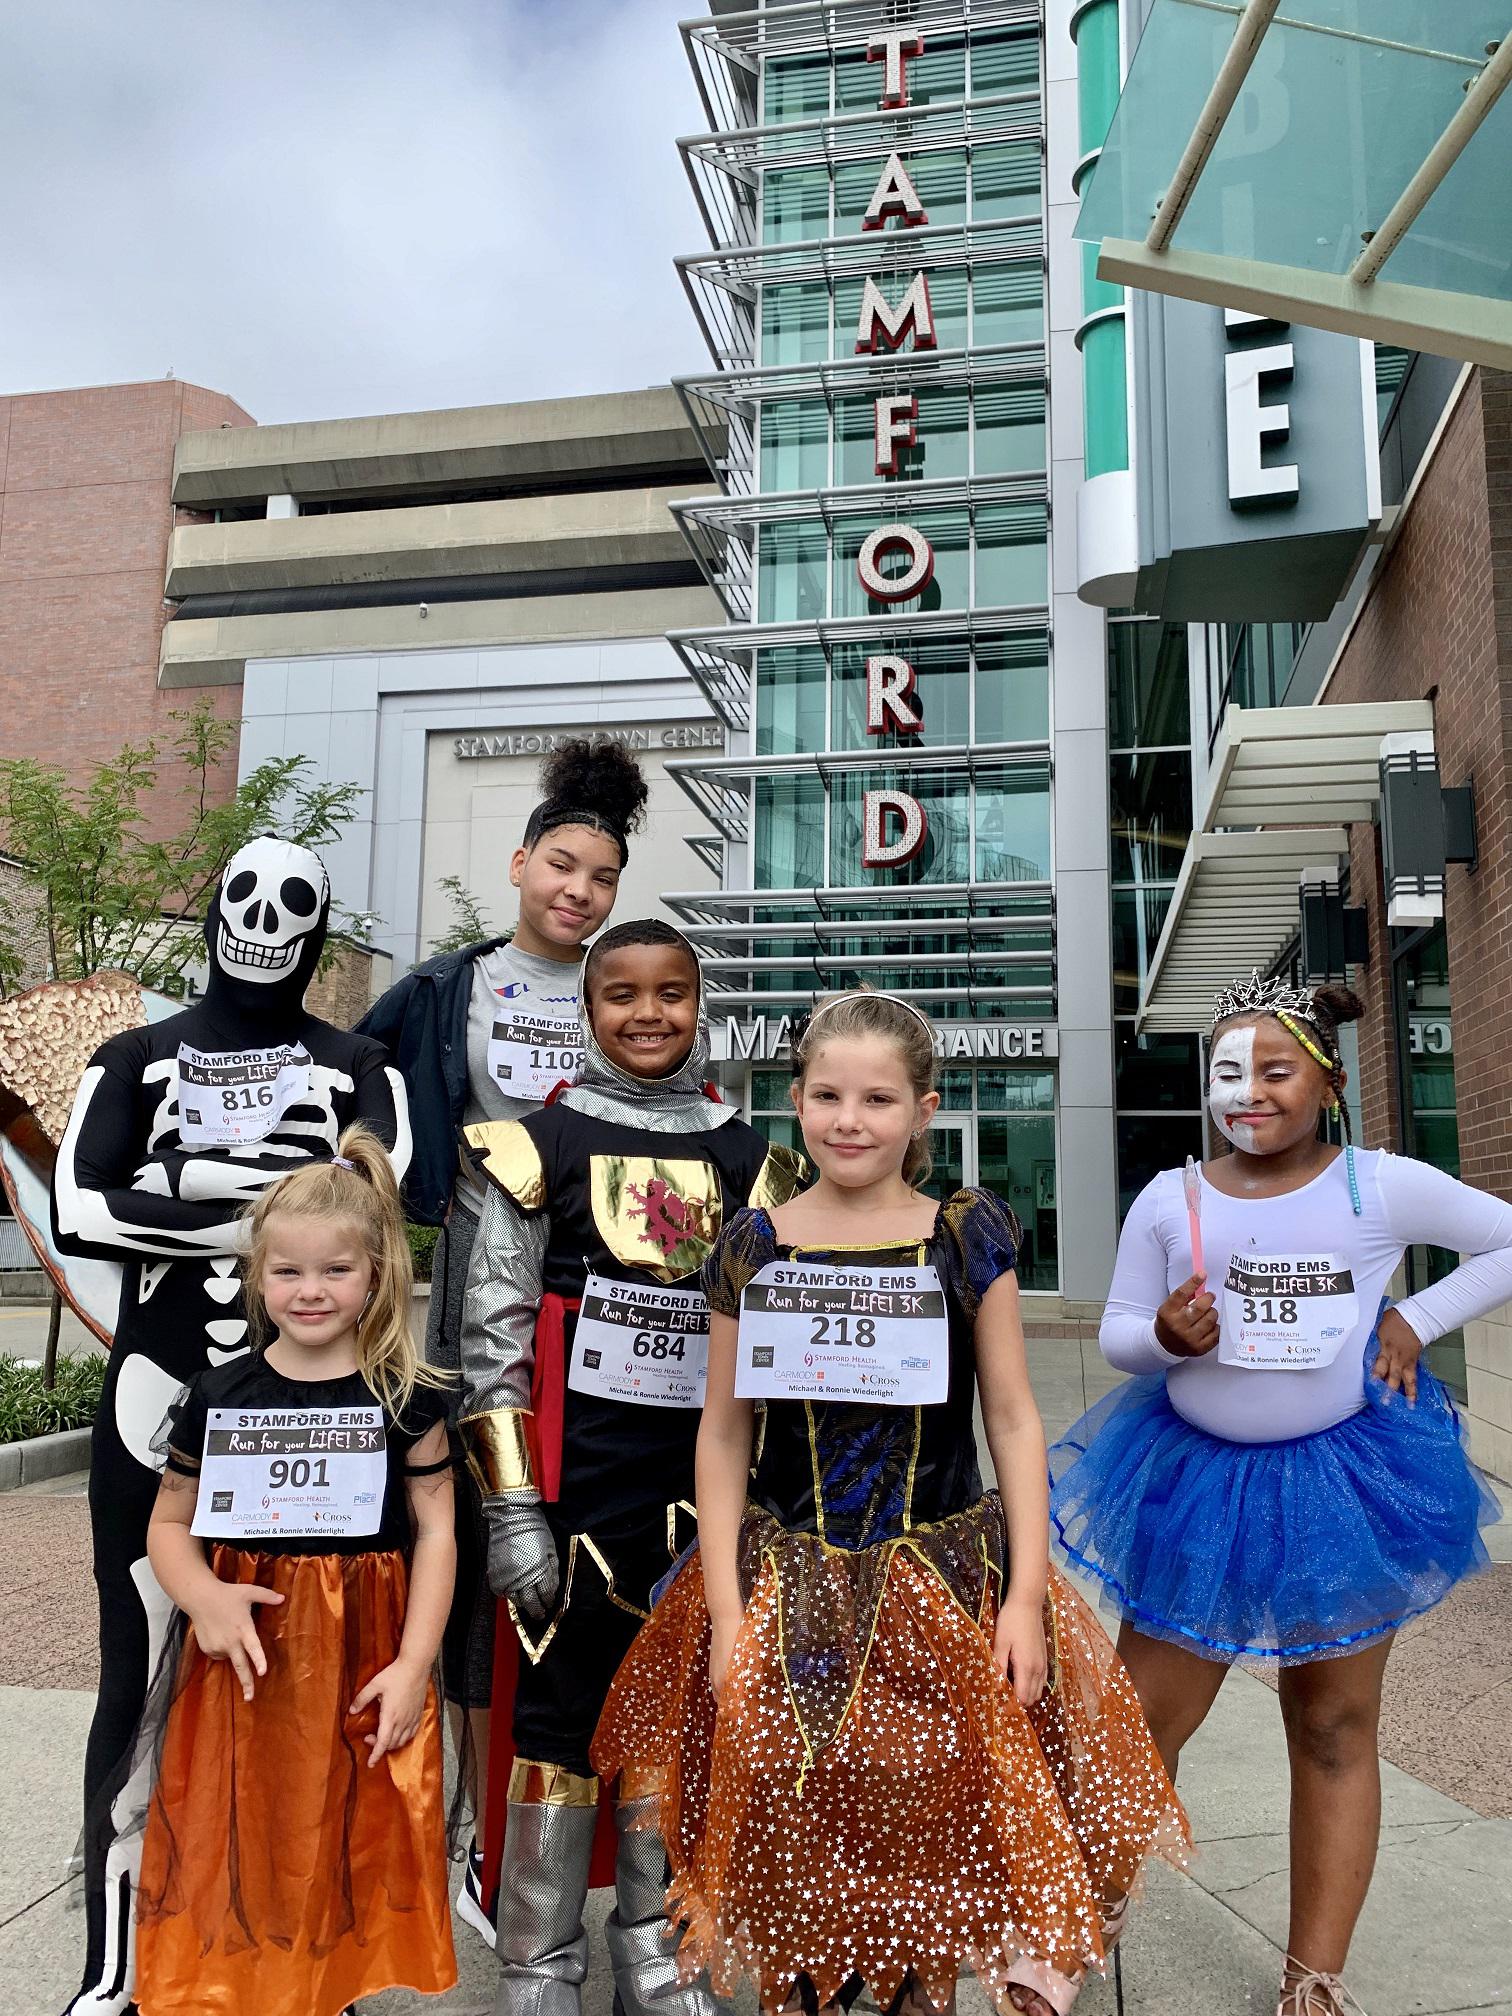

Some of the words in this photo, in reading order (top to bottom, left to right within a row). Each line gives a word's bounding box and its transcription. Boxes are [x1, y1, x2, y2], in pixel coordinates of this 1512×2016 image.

[660, 726, 725, 748] CENT
[512, 1015, 580, 1031] STAMFORD
[506, 1026, 525, 1040] Run
[529, 1030, 543, 1044] for
[564, 1033, 582, 1046] LIF
[725, 1014, 794, 1060] MA
[933, 1027, 1044, 1058] RANCE
[191, 1052, 262, 1068] STAMFORD
[188, 1067, 204, 1082] Run
[207, 1072, 223, 1085] for
[228, 1075, 245, 1086] your
[221, 1085, 274, 1111] 816
[1231, 1254, 1291, 1274] STAMFORD
[1296, 1261, 1331, 1273] EMS
[773, 1270, 873, 1288] STAMFORD
[879, 1275, 917, 1289] EMS
[1237, 1273, 1248, 1291] for
[1250, 1285, 1269, 1296] your
[1272, 1276, 1311, 1294] LIFE!
[1316, 1275, 1338, 1293] 3K
[609, 1287, 689, 1309] STAMFORD
[692, 1299, 712, 1311] EM
[766, 1288, 793, 1309] Run
[799, 1290, 819, 1312] for
[825, 1301, 846, 1313] your
[850, 1291, 894, 1314] LIFE!
[900, 1294, 924, 1315] 3K
[600, 1301, 622, 1321] Run
[626, 1307, 644, 1325] for
[648, 1319, 666, 1329] your
[669, 1312, 700, 1331] LIFE!
[704, 1314, 711, 1331] 3
[1242, 1298, 1298, 1324] 318
[810, 1316, 876, 1347] 218
[633, 1332, 686, 1362] 684
[814, 1354, 850, 1362] STAMFORD
[852, 1354, 877, 1364] HEALTH
[869, 1374, 900, 1386] CROSS
[609, 1386, 632, 1396] Michael
[639, 1391, 659, 1400] Ronnie
[660, 1394, 692, 1402] Wiederlight
[788, 1384, 817, 1393] Michael
[818, 1385, 824, 1393] &
[825, 1385, 851, 1394] Ronnie
[852, 1387, 894, 1397] Wiederlight
[238, 1412, 333, 1428] STAMFORD
[338, 1412, 375, 1426] EMS
[228, 1432, 255, 1452] Run
[260, 1432, 280, 1453] for
[285, 1441, 305, 1453] your
[309, 1430, 351, 1449] LIFE!
[358, 1430, 379, 1449] 3K
[269, 1458, 330, 1489] 901
[322, 1511, 352, 1522] CROSS
[243, 1528, 271, 1536] Michael
[279, 1527, 303, 1535] Ronnie
[304, 1527, 345, 1536] Wiederlight
